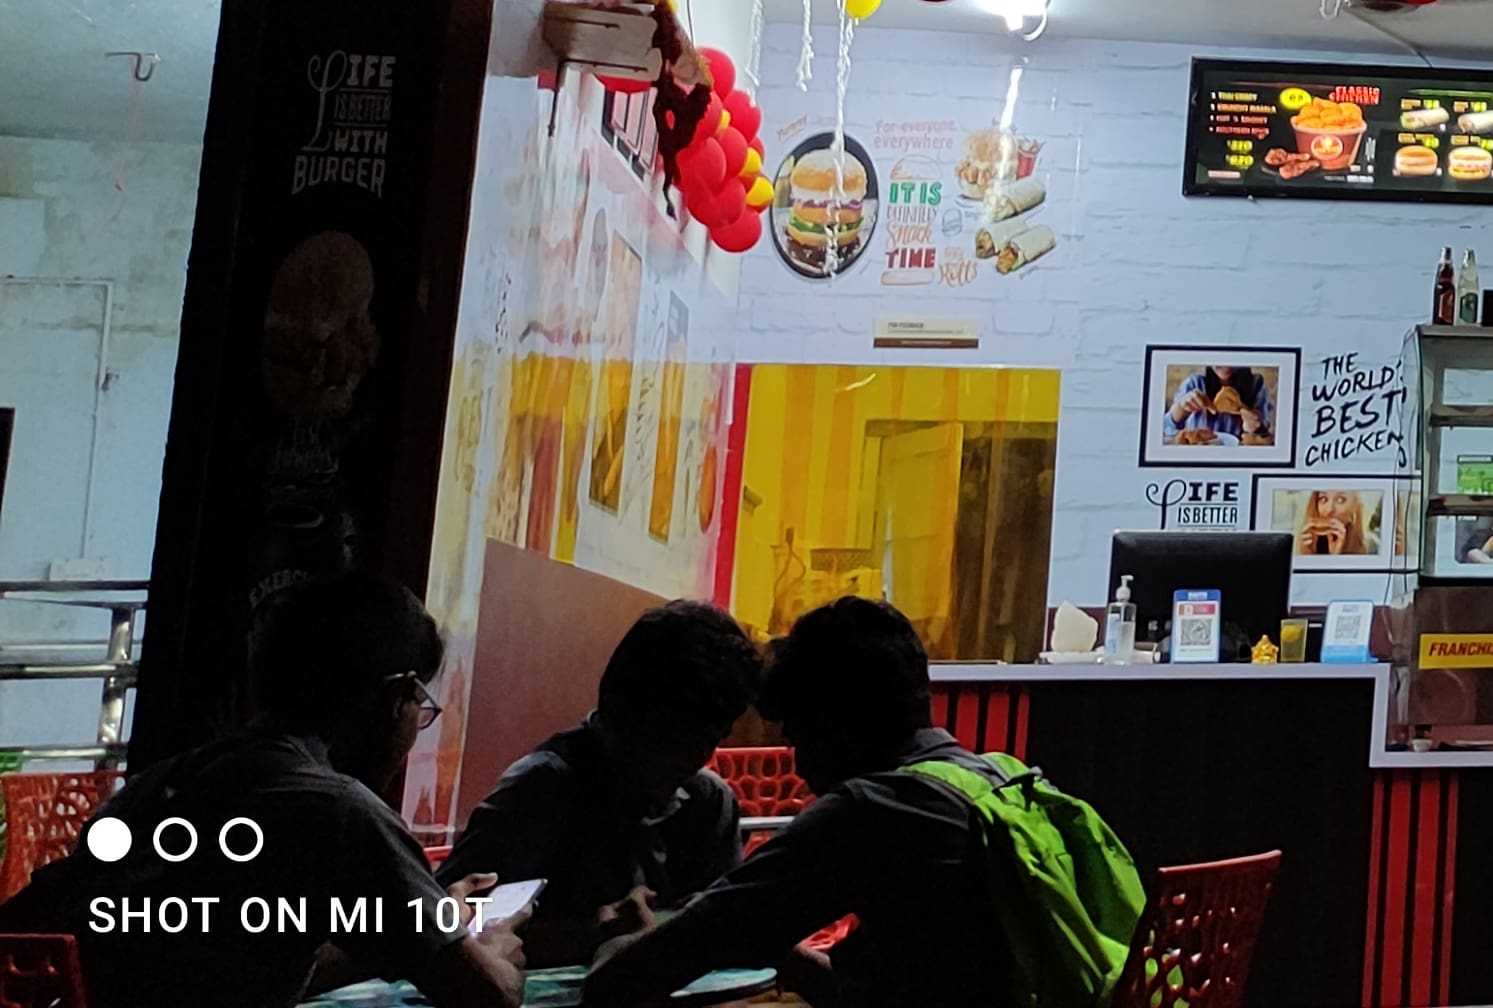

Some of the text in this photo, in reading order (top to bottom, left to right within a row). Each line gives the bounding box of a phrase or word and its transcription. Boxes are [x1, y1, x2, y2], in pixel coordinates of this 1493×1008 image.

[334, 128, 388, 155] WITH
[291, 154, 386, 199] BURGER
[889, 181, 942, 206] IT IS
[885, 246, 937, 269] TIME
[1321, 352, 1359, 380] THE
[1305, 429, 1407, 468] CHICKEN
[1192, 506, 1238, 524] BETTER
